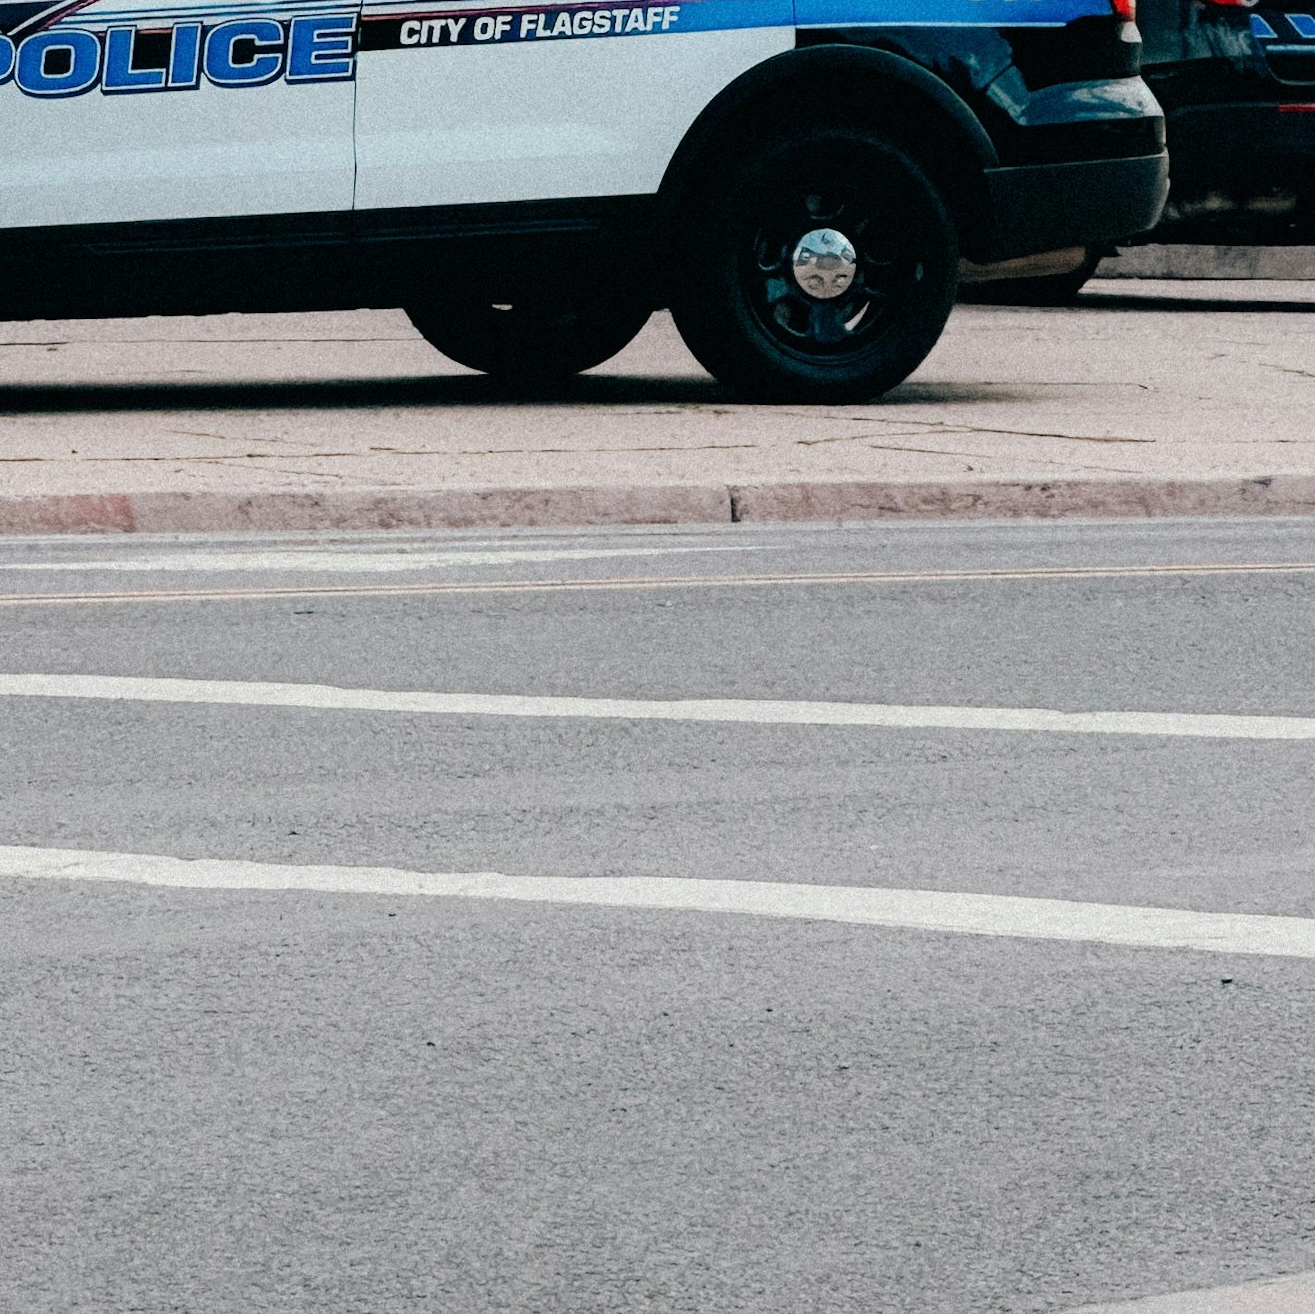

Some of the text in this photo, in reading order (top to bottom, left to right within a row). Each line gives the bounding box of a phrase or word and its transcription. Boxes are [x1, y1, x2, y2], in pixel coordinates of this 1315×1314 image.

[399, 5, 681, 45] CITY OF FLAGSTAFF
